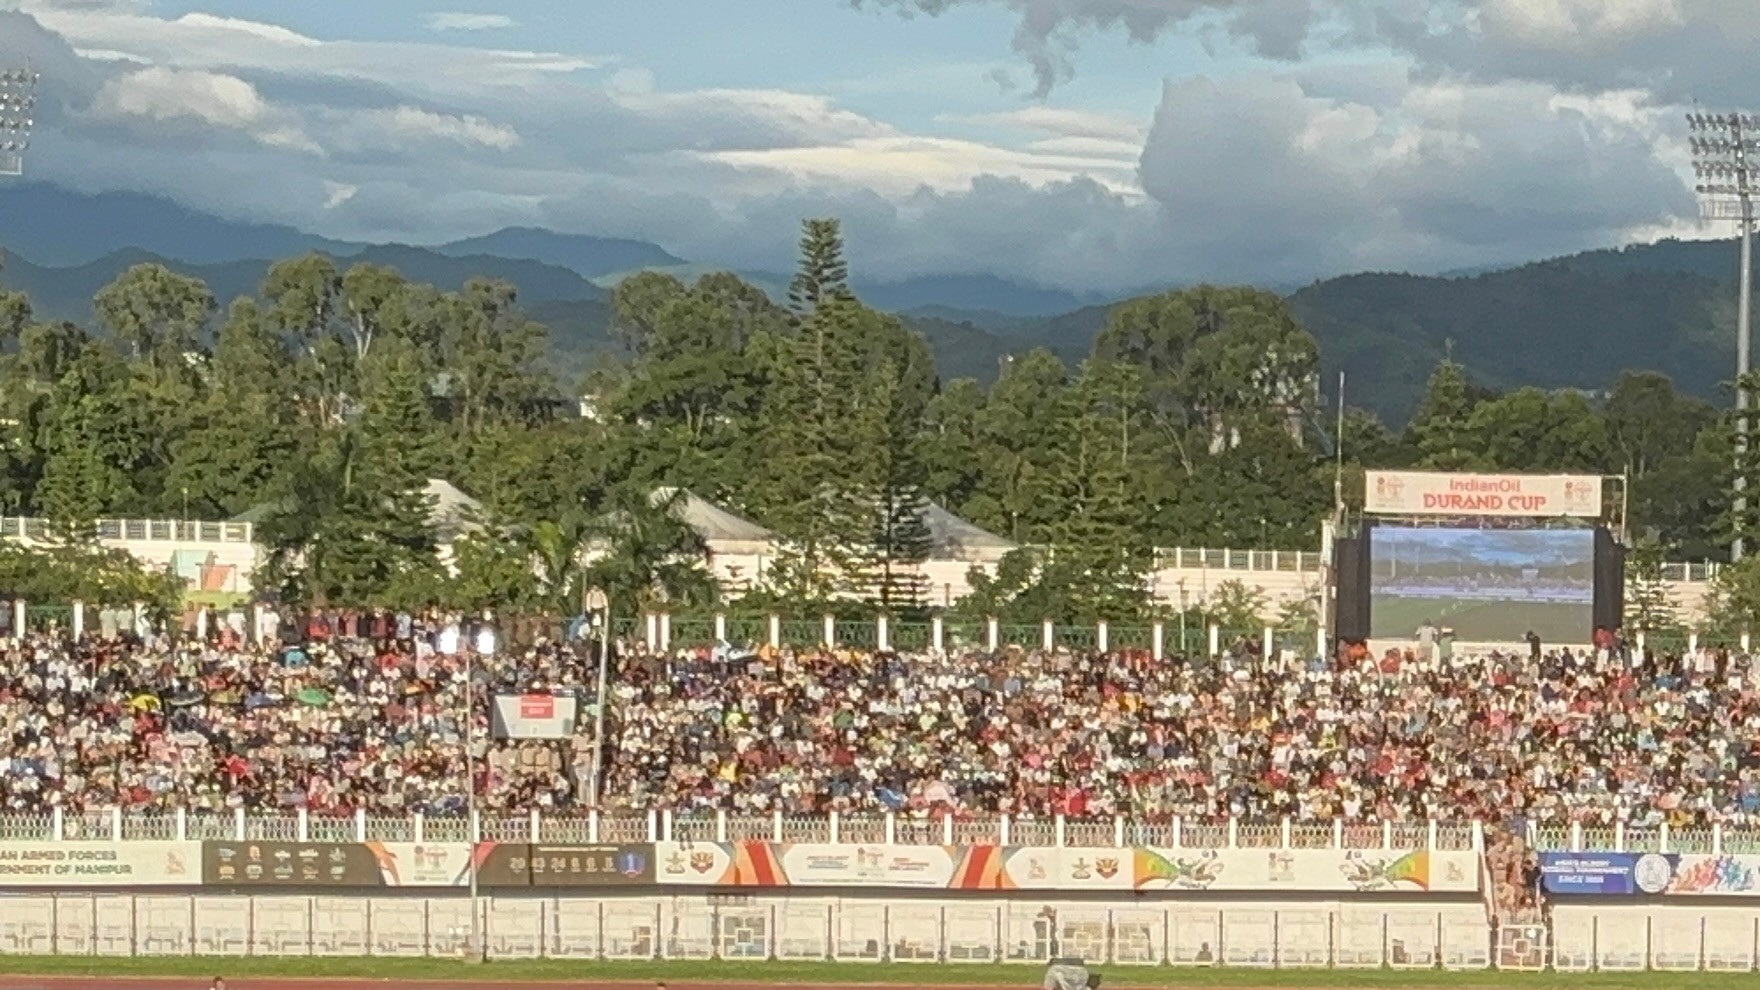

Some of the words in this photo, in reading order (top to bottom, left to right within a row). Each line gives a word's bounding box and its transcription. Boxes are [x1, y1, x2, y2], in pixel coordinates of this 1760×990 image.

[1449, 478, 1521, 492] IndianOil
[1423, 494, 1503, 511] DURAND
[1508, 495, 1547, 512] CUP
[21, 850, 66, 861] ARMED
[69, 850, 117, 861] FORCES
[54, 865, 71, 875] OF
[75, 865, 133, 876] MANIPUR
